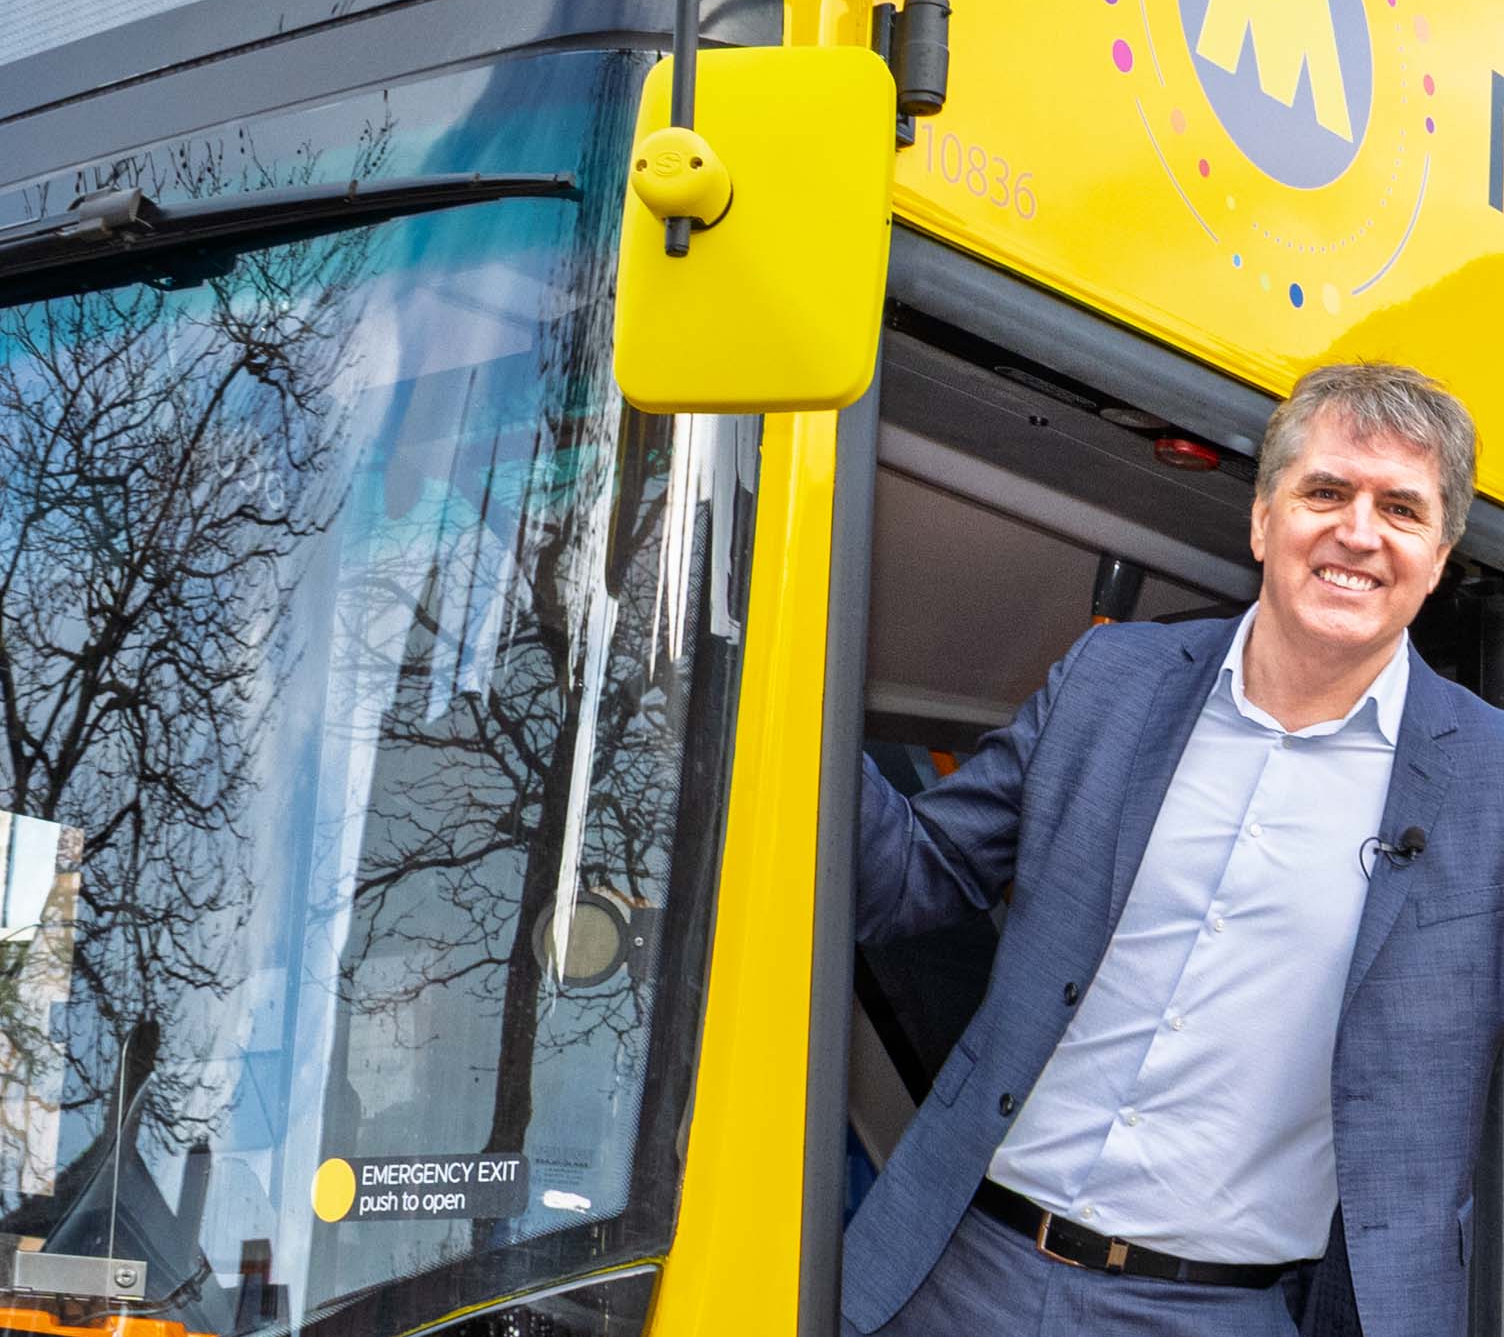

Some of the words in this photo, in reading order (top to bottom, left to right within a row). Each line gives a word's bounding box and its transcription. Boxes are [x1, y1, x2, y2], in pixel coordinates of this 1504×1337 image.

[921, 123, 1037, 220] 10836
[361, 1162, 473, 1186] EMERGENCY
[477, 1160, 520, 1184] EXIT
[359, 1192, 398, 1216] push
[401, 1192, 419, 1212] to
[422, 1191, 465, 1215] open
